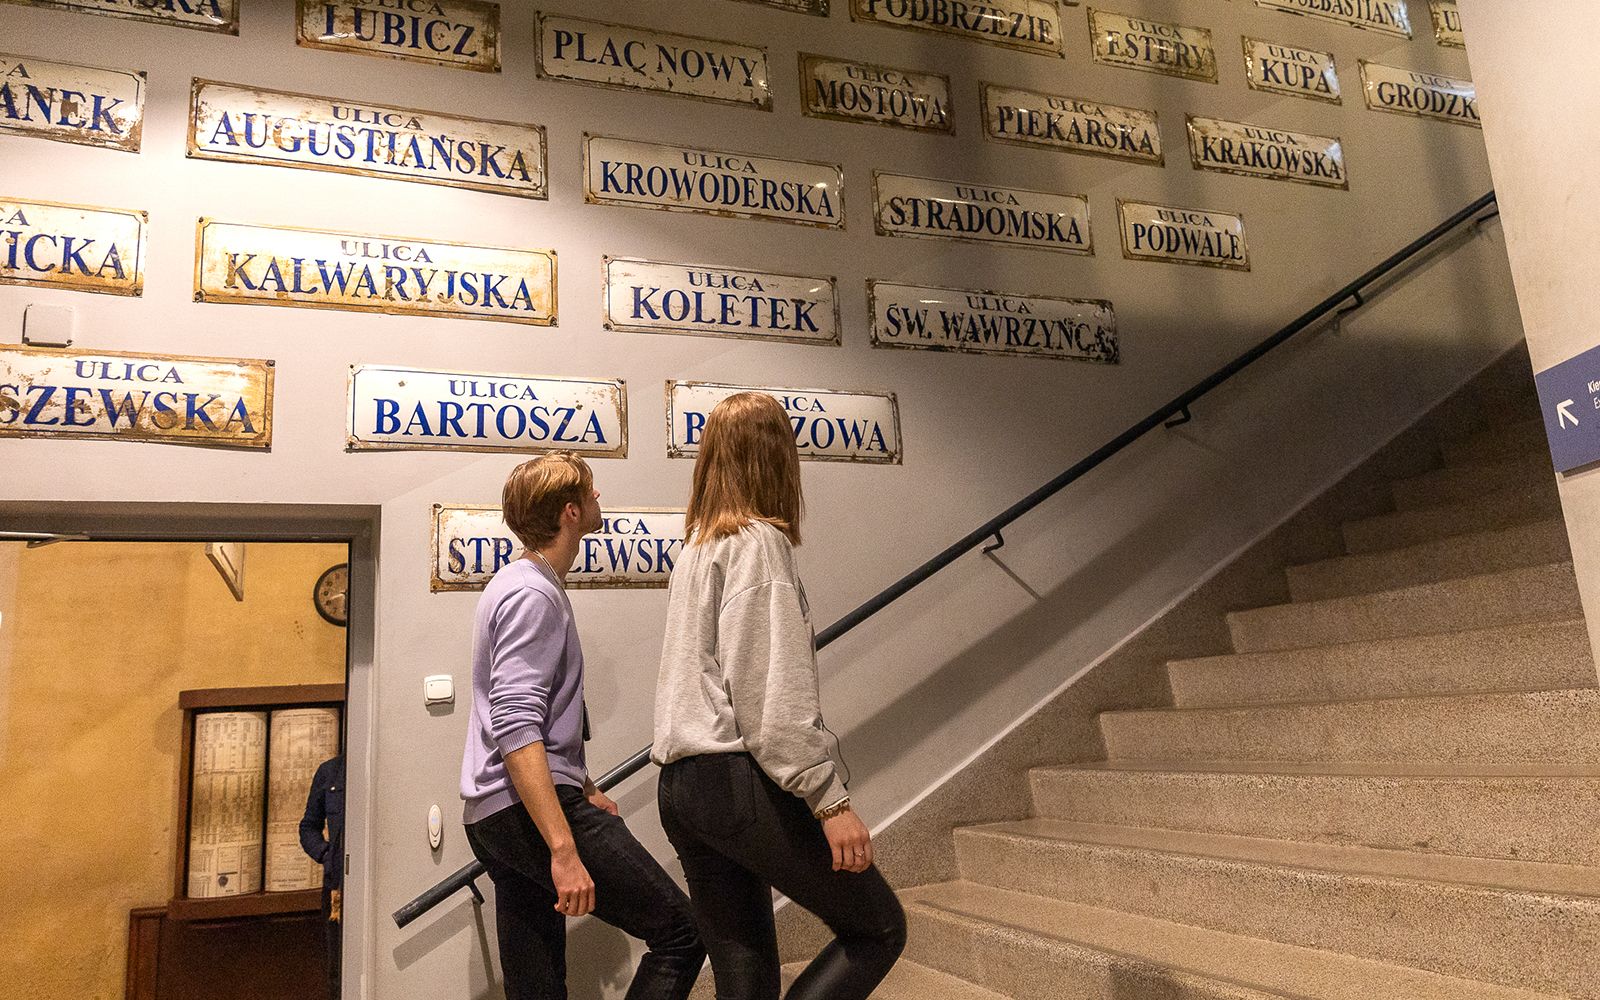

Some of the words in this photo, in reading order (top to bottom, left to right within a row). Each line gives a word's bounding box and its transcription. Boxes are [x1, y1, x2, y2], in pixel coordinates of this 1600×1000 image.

[322, 4, 478, 57] LUBICZ
[1127, 19, 1184, 40] ULICA
[552, 29, 647, 71] PLAC
[655, 44, 758, 87] NOWY
[1106, 29, 1208, 70] ESTERY
[1268, 46, 1319, 65] ULICA
[845, 66, 912, 87] ULICA
[1260, 58, 1333, 94] KUPA
[1409, 73, 1454, 89] ULICA
[814, 79, 946, 124] MOSTOWA
[1047, 98, 1107, 118] ULICA
[1377, 81, 1480, 120] GRODZK
[332, 106, 424, 131] ULICA
[996, 106, 1157, 155] PIEKARSKA
[210, 111, 533, 182] AUGUSTIAŃSKA
[1245, 128, 1299, 145] ULICA
[683, 152, 758, 174] ULICA
[1201, 135, 1342, 179] KRAKOWSKA
[601, 161, 834, 217] KROWODERSKA
[956, 187, 1020, 206] ULICA
[890, 197, 1083, 244] STRADOMSKA
[1157, 210, 1214, 228] ULICA
[0, 230, 128, 280] ICKA
[340, 240, 434, 263] ULICA
[1132, 223, 1243, 260] PODWALE
[224, 253, 536, 311] KALWARYJSKA
[688, 271, 765, 292] ULICA
[630, 286, 819, 332] KOLETEK
[966, 295, 1032, 314] ULICA
[886, 303, 932, 338] ŚW.
[75, 360, 184, 384] ULICA
[449, 379, 539, 400] ULICA
[781, 395, 827, 413] ICA
[372, 398, 607, 444] BARTOSZA
[592, 518, 651, 535] ICA
